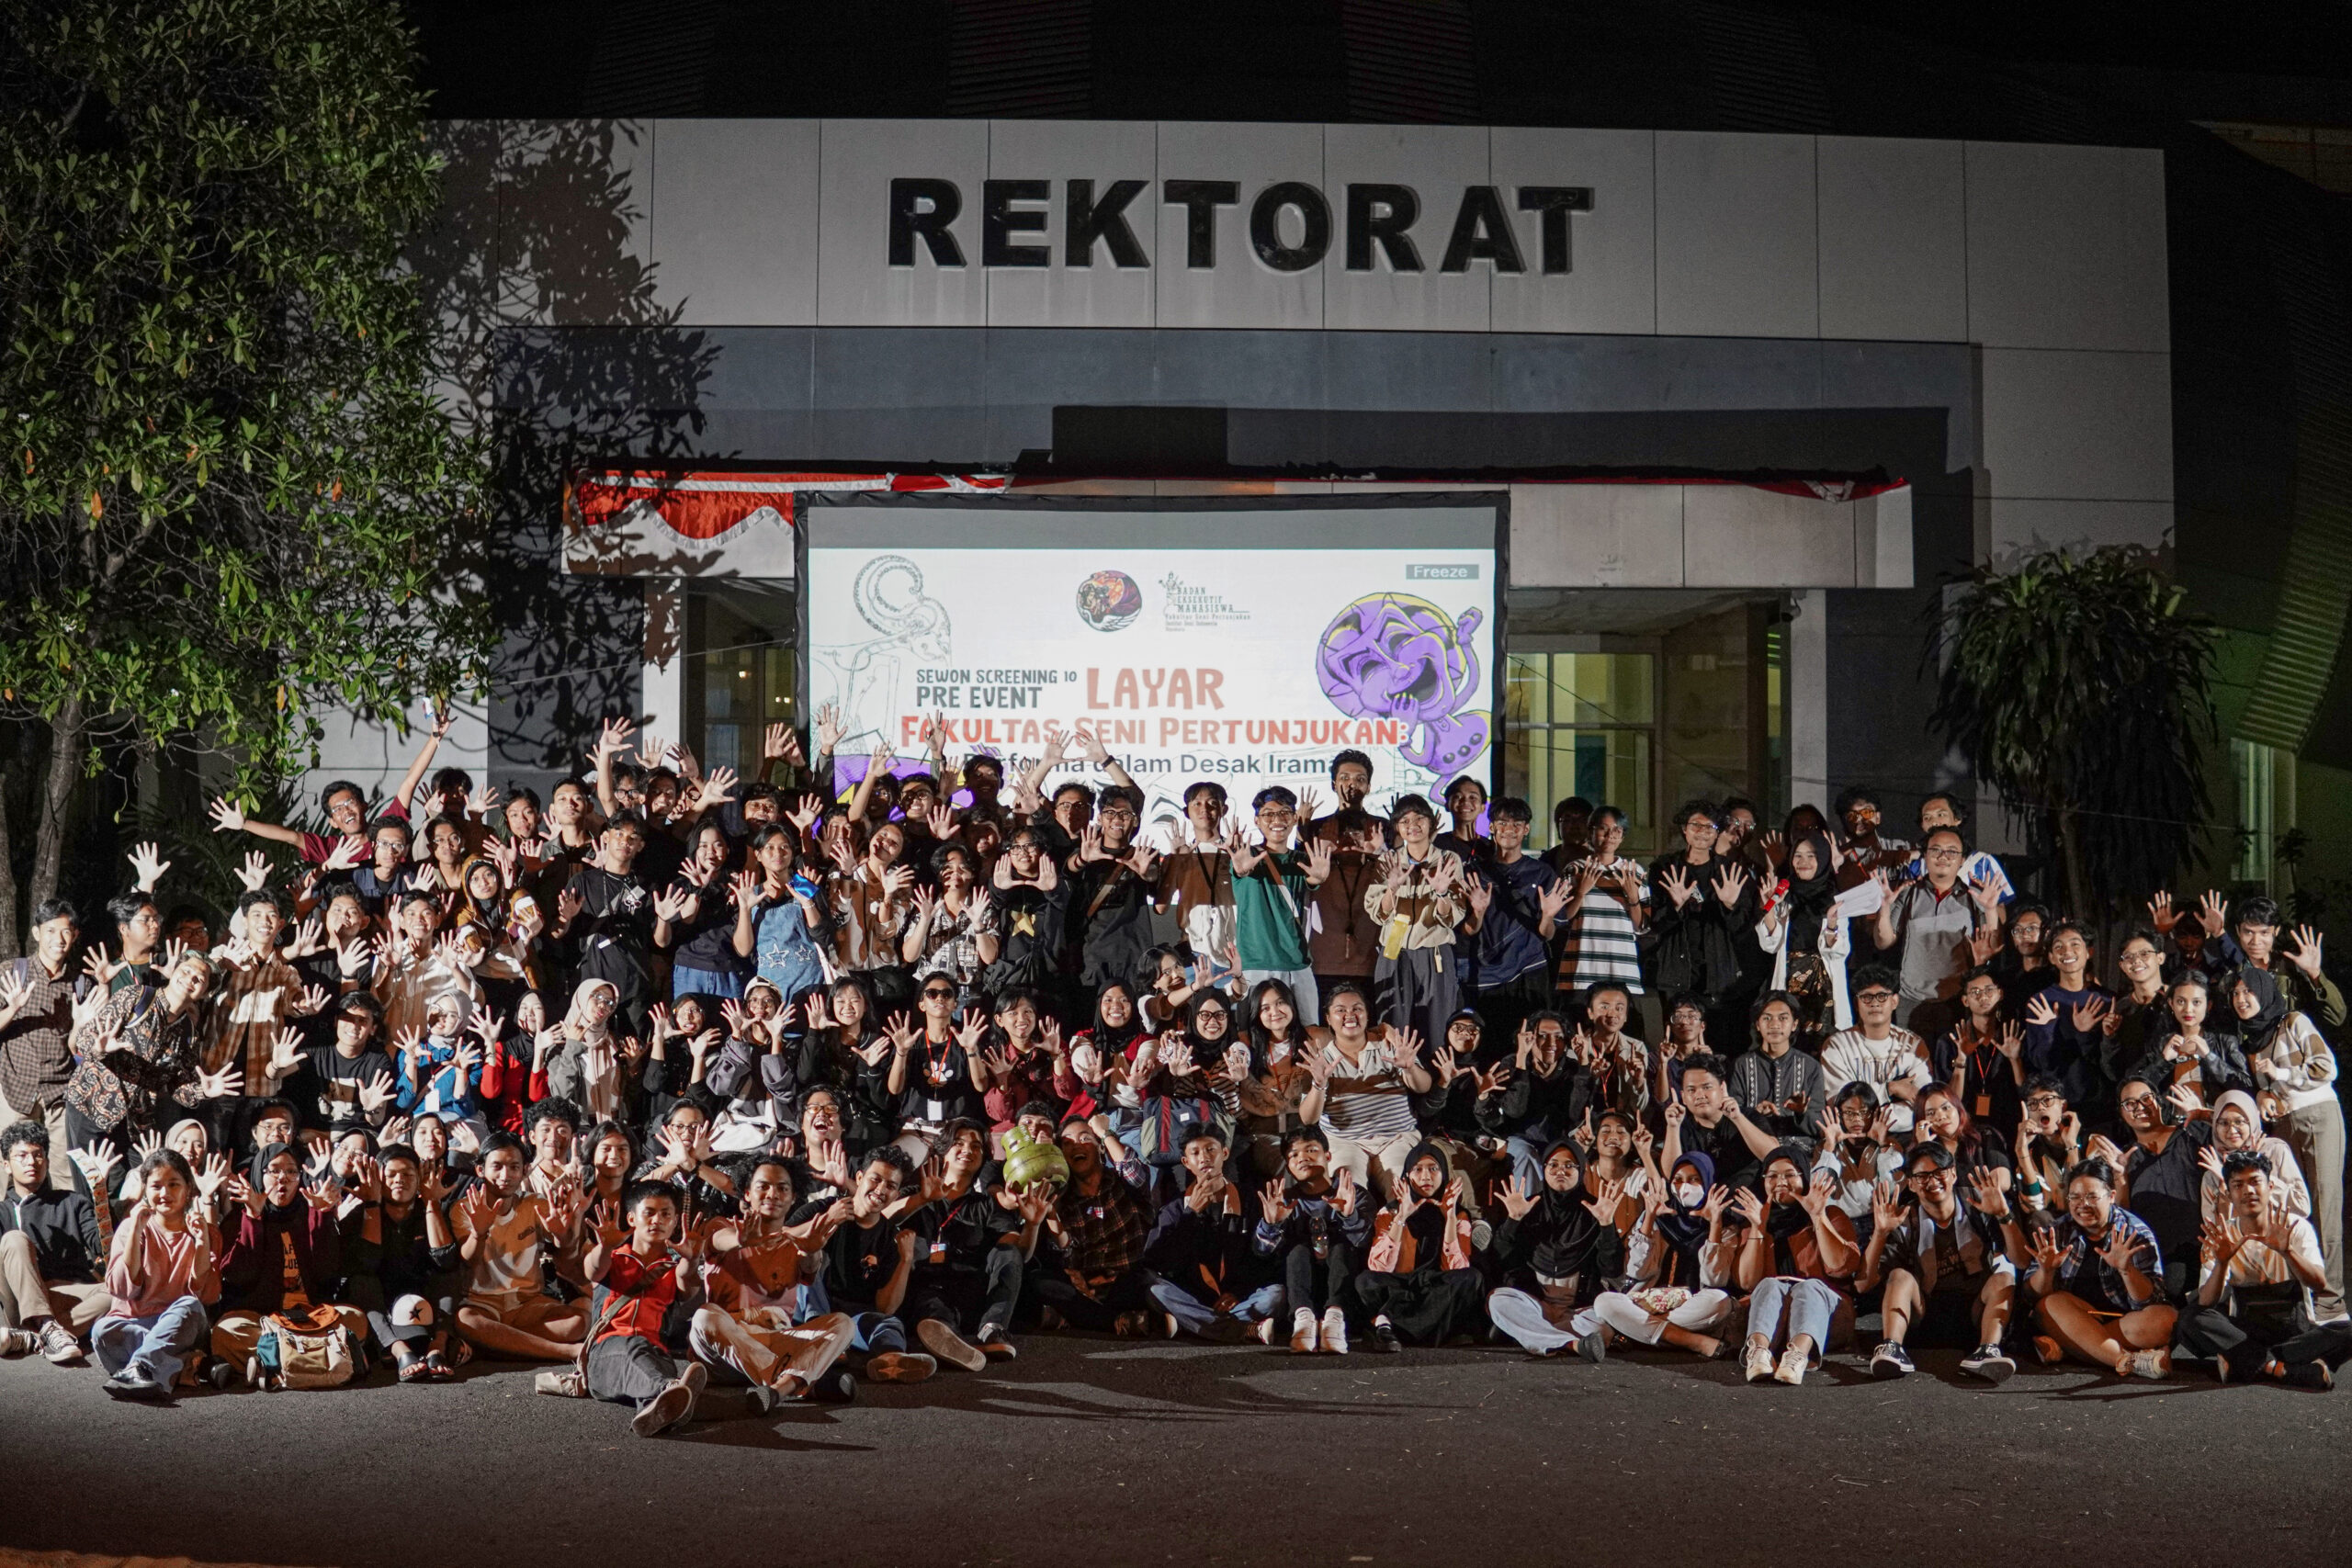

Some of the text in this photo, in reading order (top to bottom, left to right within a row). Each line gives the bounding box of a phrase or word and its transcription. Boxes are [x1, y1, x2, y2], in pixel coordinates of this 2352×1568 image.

[887, 176, 1596, 275] REKTORAT
[1413, 565, 1468, 578] Freeze
[1177, 587, 1205, 595] BADAN
[1177, 604, 1234, 613] MAHASISWA
[916, 670, 1077, 684] SEWON SCREENING 10
[916, 686, 1043, 709] PRE EVENT
[1087, 668, 1225, 710] LAYAR
[1074, 716, 1146, 748] SENI
[1159, 717, 1407, 748] PERTUNJUKAN:
[1181, 753, 1261, 773] Desak
[1269, 753, 1334, 773] Iram
